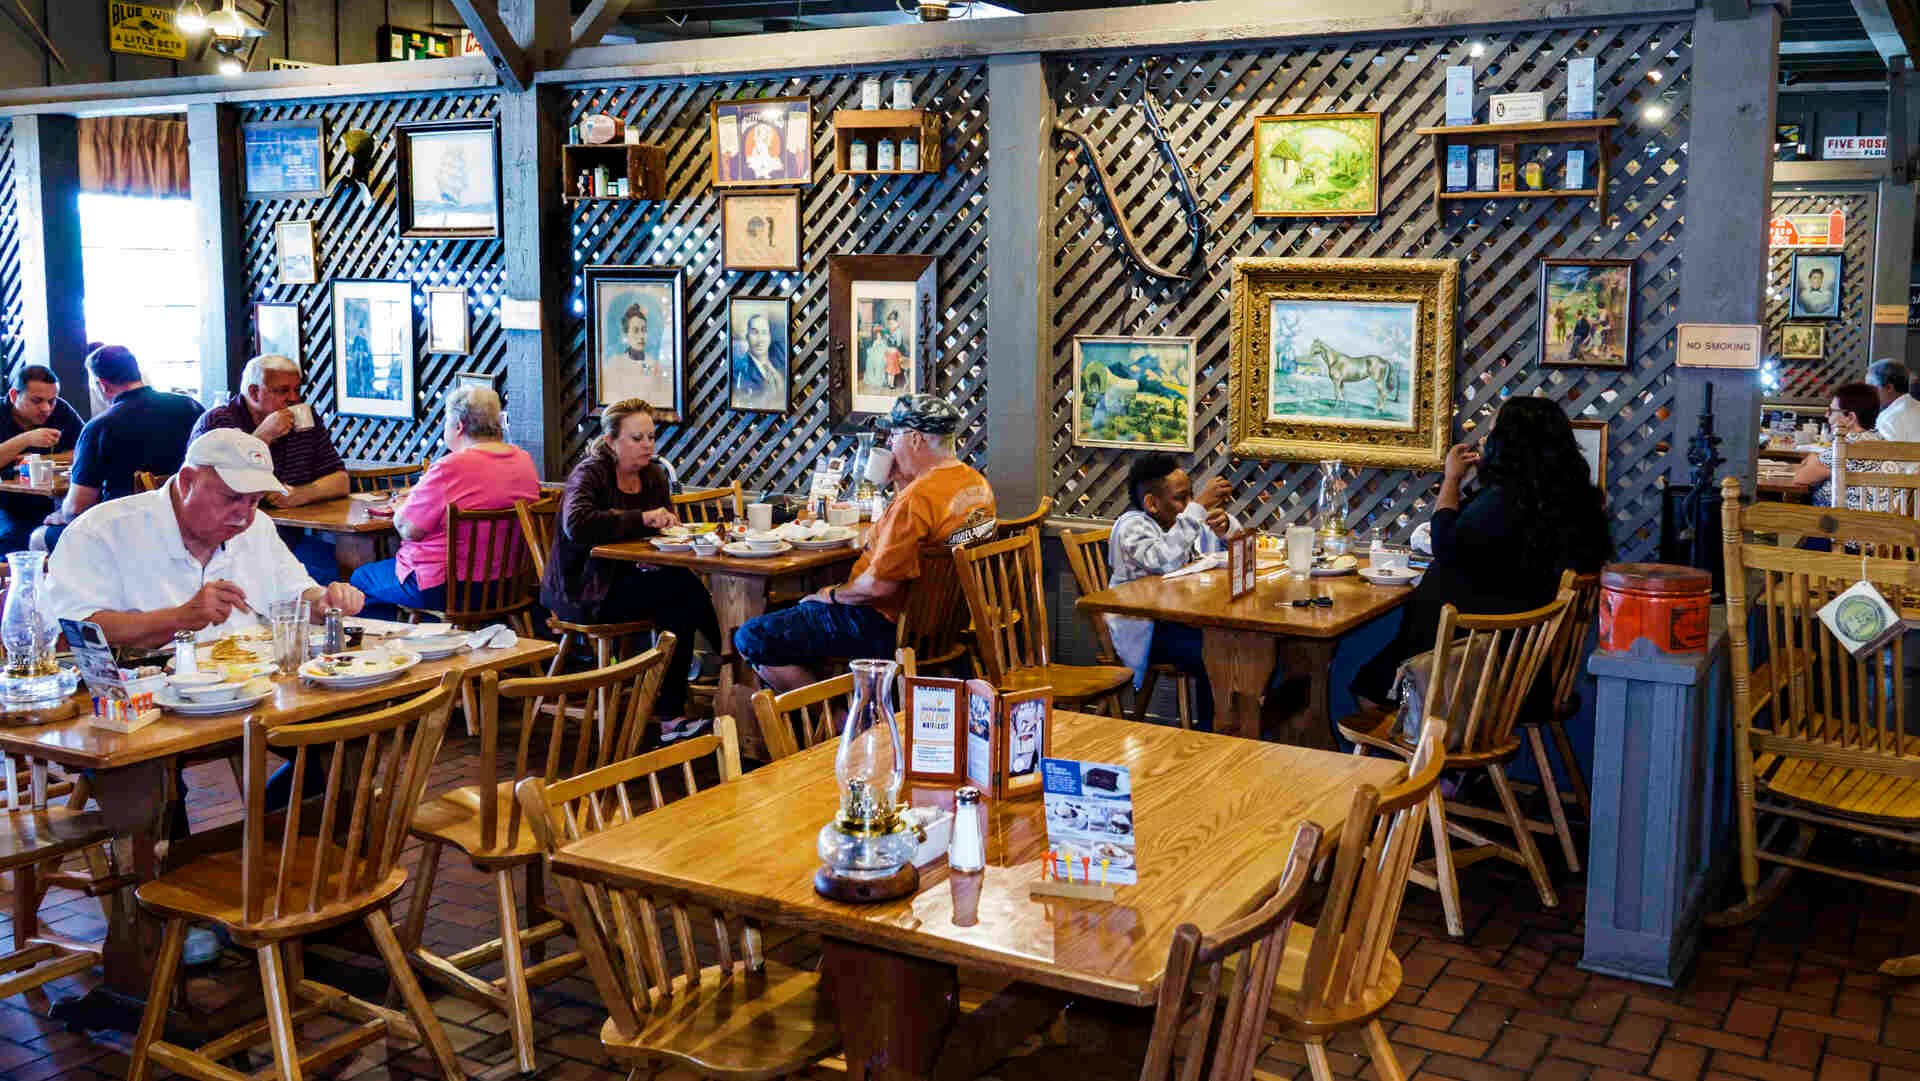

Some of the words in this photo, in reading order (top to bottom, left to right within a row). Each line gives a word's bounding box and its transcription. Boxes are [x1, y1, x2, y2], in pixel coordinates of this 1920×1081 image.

[112, 4, 142, 26] BLUE
[1828, 138, 1854, 149] FIVE
[1687, 342, 1702, 350] NO
[1705, 342, 1751, 351] SMOKING
